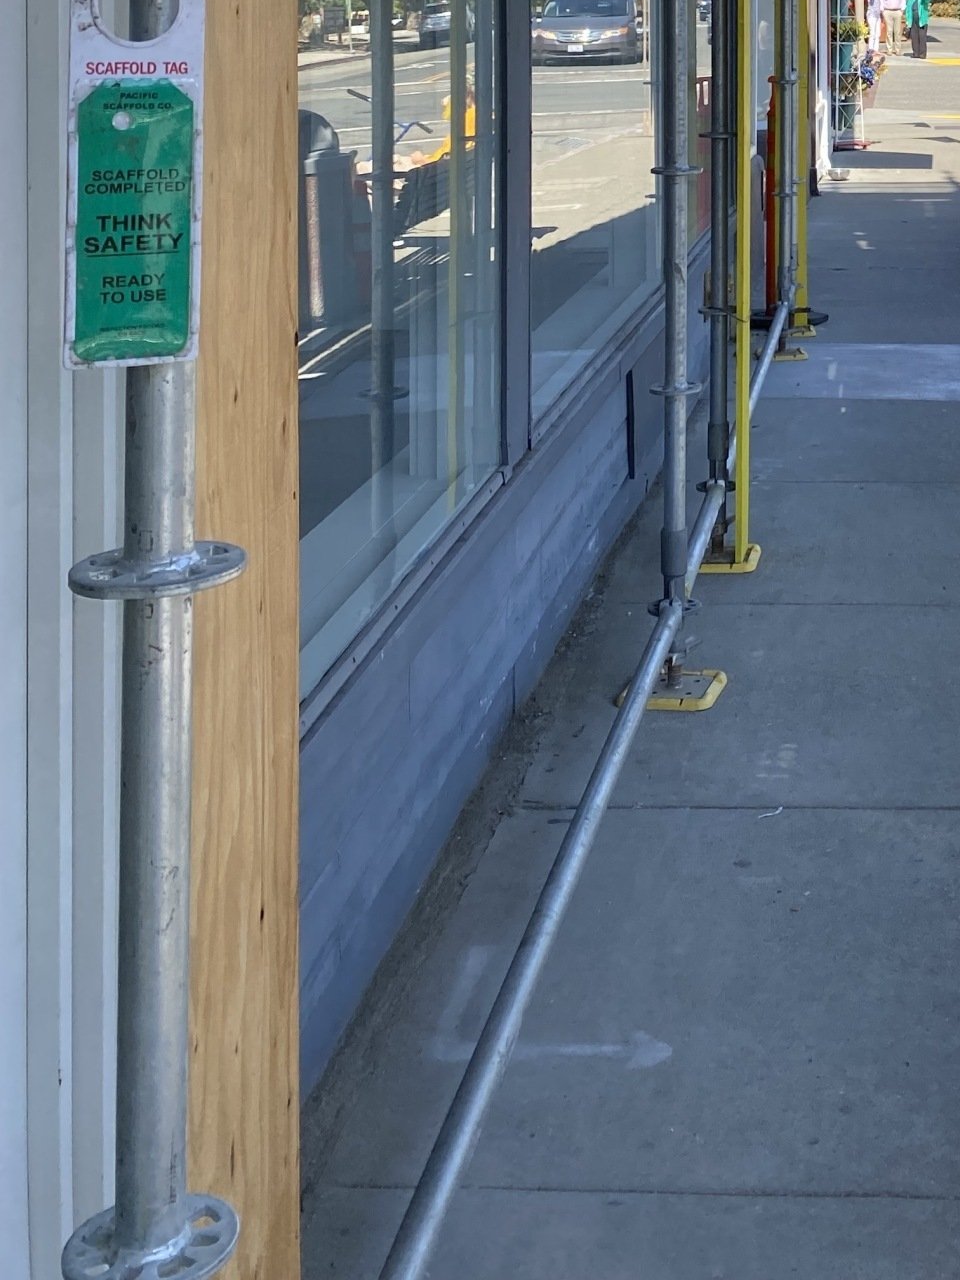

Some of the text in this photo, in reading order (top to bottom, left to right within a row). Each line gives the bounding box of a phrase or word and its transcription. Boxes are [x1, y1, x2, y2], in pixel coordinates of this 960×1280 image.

[85, 61, 188, 75] SCAFFOLD TAG
[120, 92, 158, 100] PACIFIC
[103, 102, 155, 110] SCAFFOLD
[92, 168, 179, 182] SCAFFOLD
[84, 181, 186, 195] COMPLETED
[96, 213, 172, 233] THINK
[84, 232, 184, 254] SAFETY
[102, 273, 166, 289] READY
[100, 288, 167, 305] TO USE
